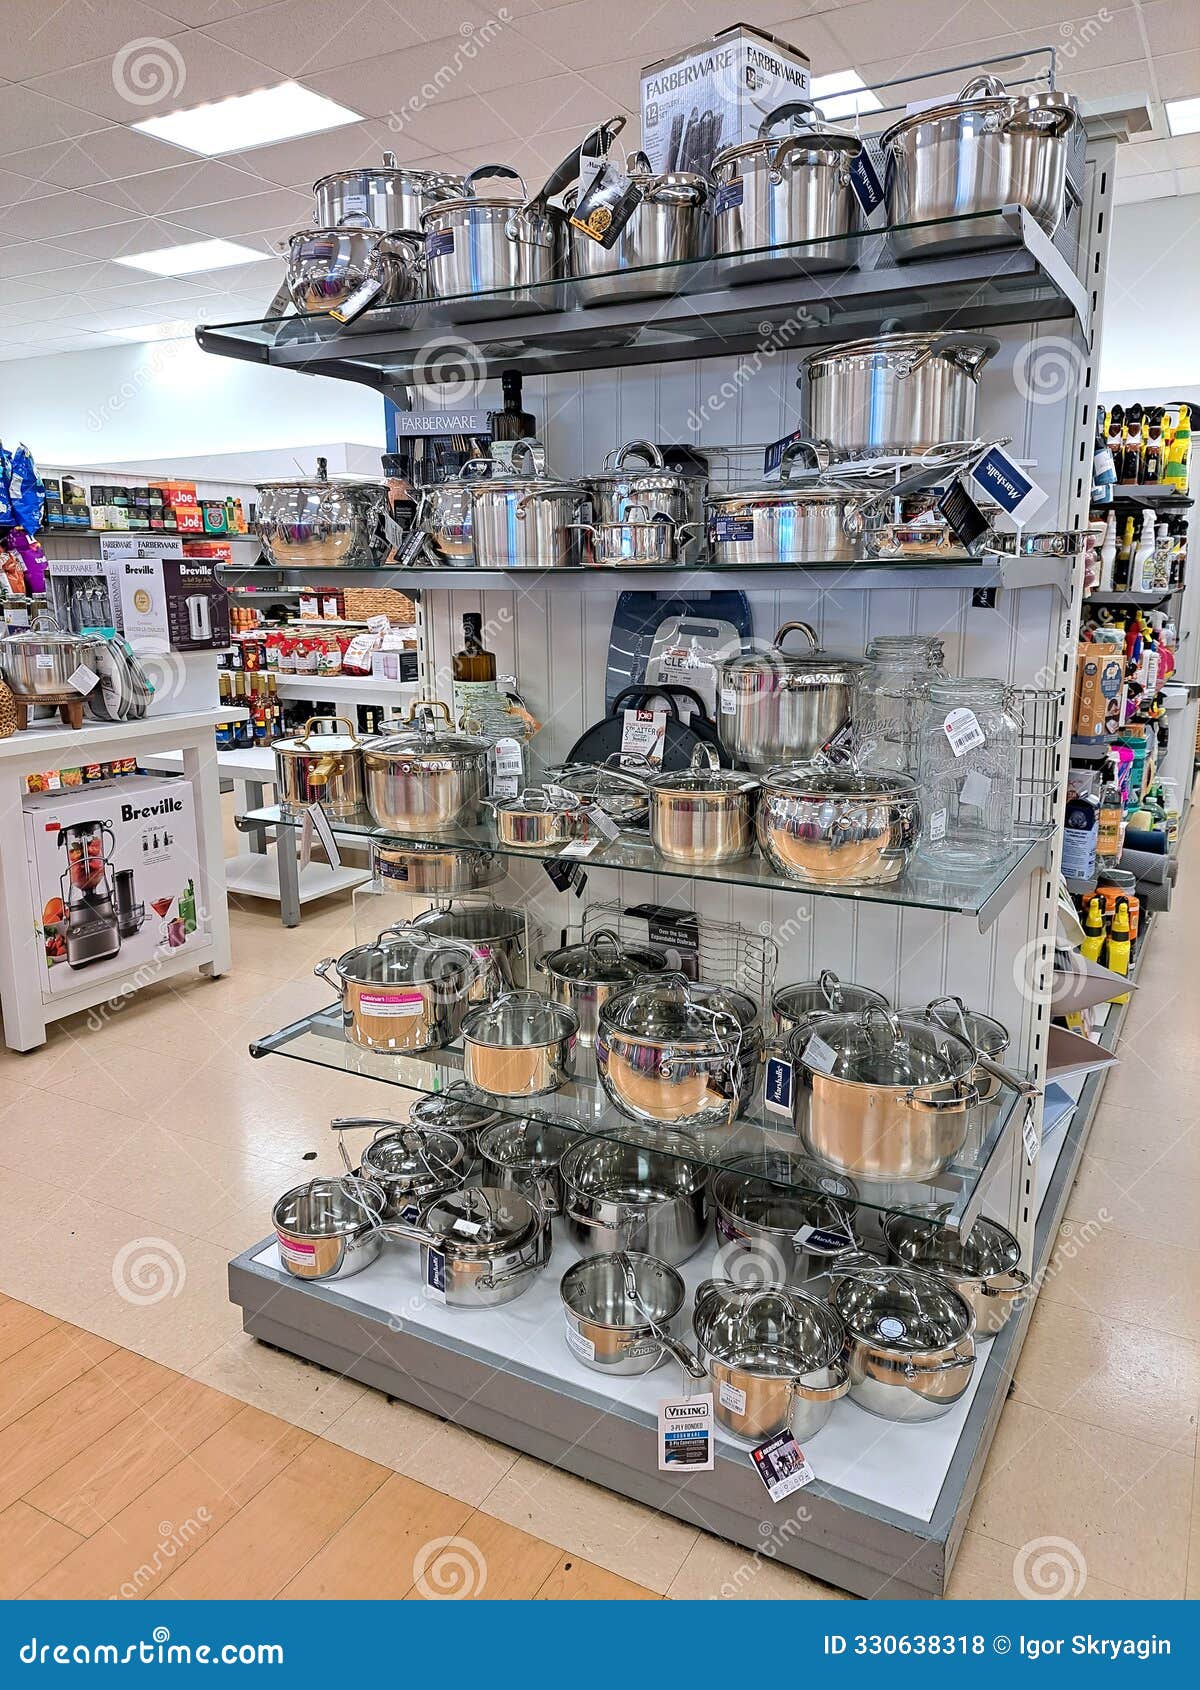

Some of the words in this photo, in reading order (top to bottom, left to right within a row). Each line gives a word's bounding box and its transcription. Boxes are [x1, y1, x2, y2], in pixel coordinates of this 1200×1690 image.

[646, 49, 734, 101] FARBERWARE
[746, 46, 807, 90] FARBERWARE
[857, 159, 879, 204] Marshalls
[401, 415, 477, 432] FARBERWARE
[986, 462, 1021, 499] Marshalls
[138, 541, 180, 549] FARBERWARE
[52, 564, 94, 572] FARBERWARE
[125, 564, 154, 575] Breville
[180, 564, 213, 575] Breville
[121, 797, 183, 822] Breville
[774, 1065, 783, 1102] Marshalls
[811, 1234, 841, 1247] Marshalls
[432, 1255, 441, 1288] Marshalls
[669, 1406, 706, 1417] VIKING
[684, 1423, 703, 1431] BONDED
[673, 1431, 701, 1439] COOKWARE
